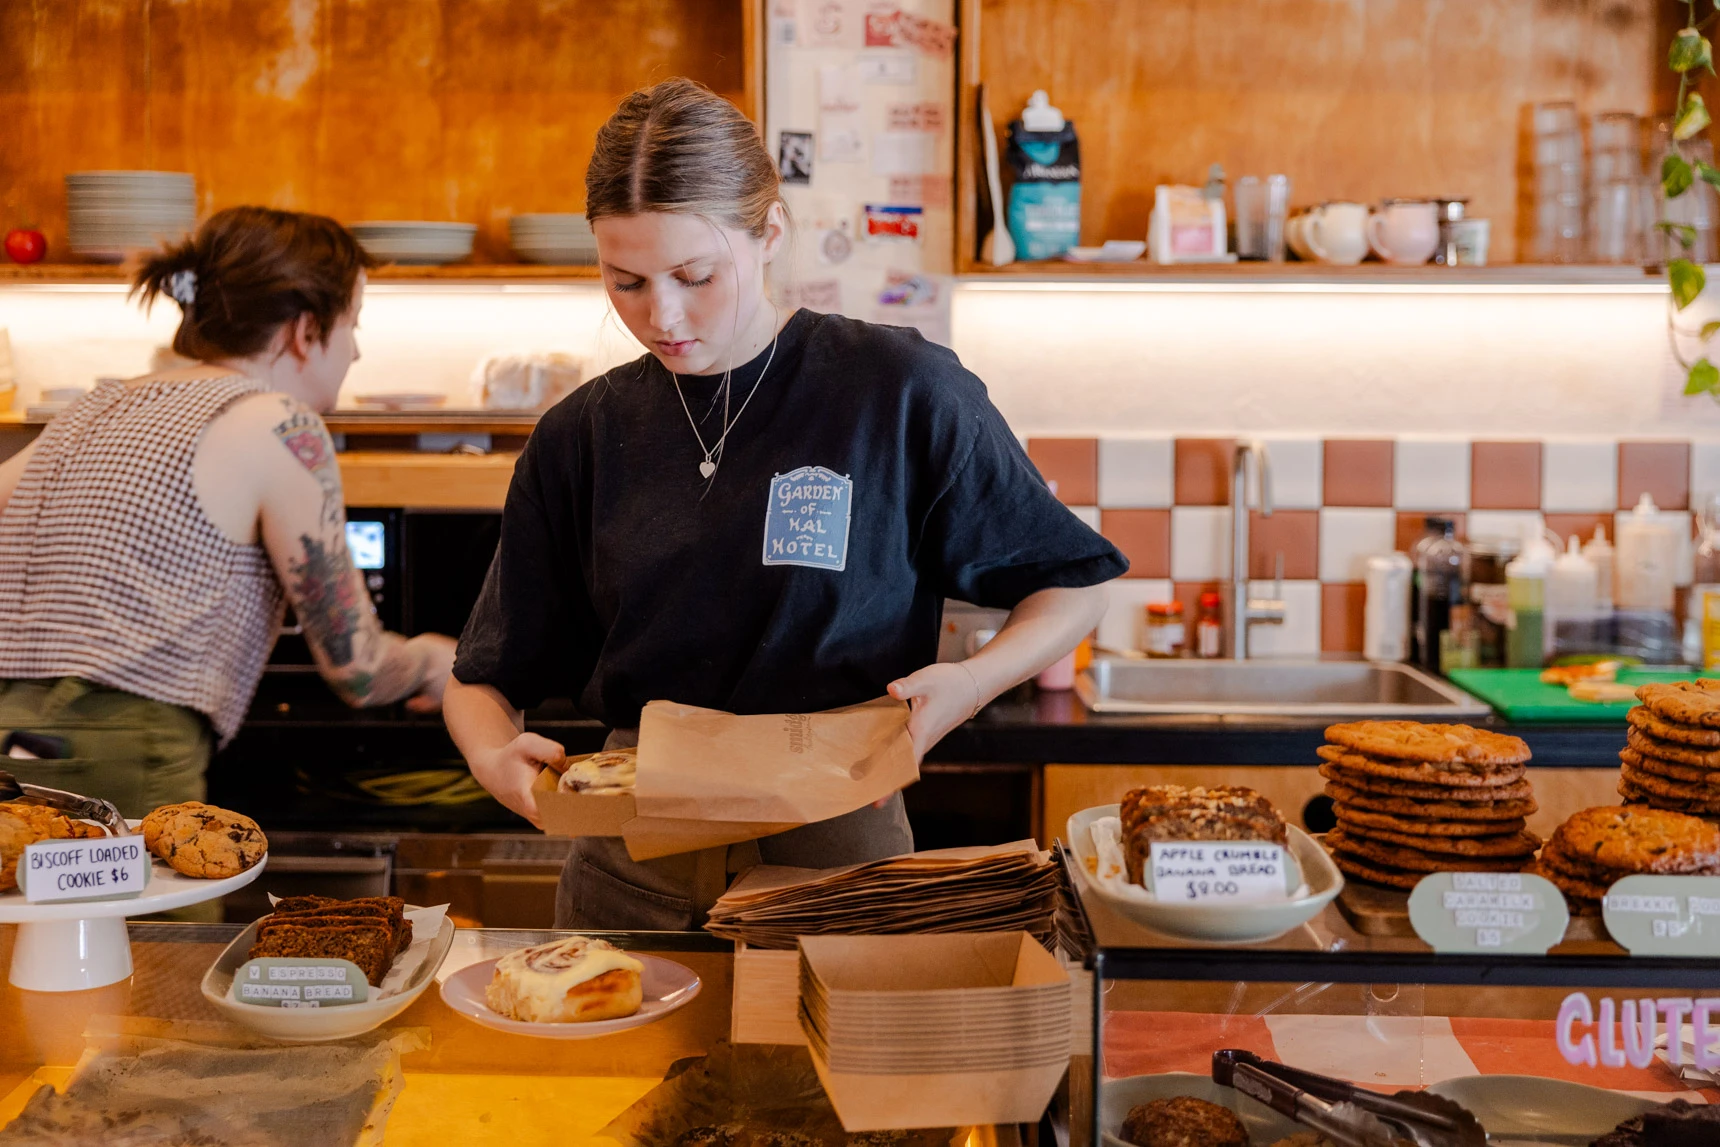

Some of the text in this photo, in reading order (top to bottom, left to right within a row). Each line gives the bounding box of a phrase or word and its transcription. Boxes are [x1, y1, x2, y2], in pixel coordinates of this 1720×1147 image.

[772, 537, 838, 558] HOTEL
[31, 844, 139, 870] BISCOFF LOADED
[1159, 848, 1279, 862] APPLE CRUMBLE
[57, 866, 129, 891] COOKIE $6
[1455, 876, 1519, 888] SALTED
[1455, 912, 1520, 925] COOKIE
[270, 966, 345, 979] ESPRESSO
[243, 986, 350, 998] BANANA BREAD
